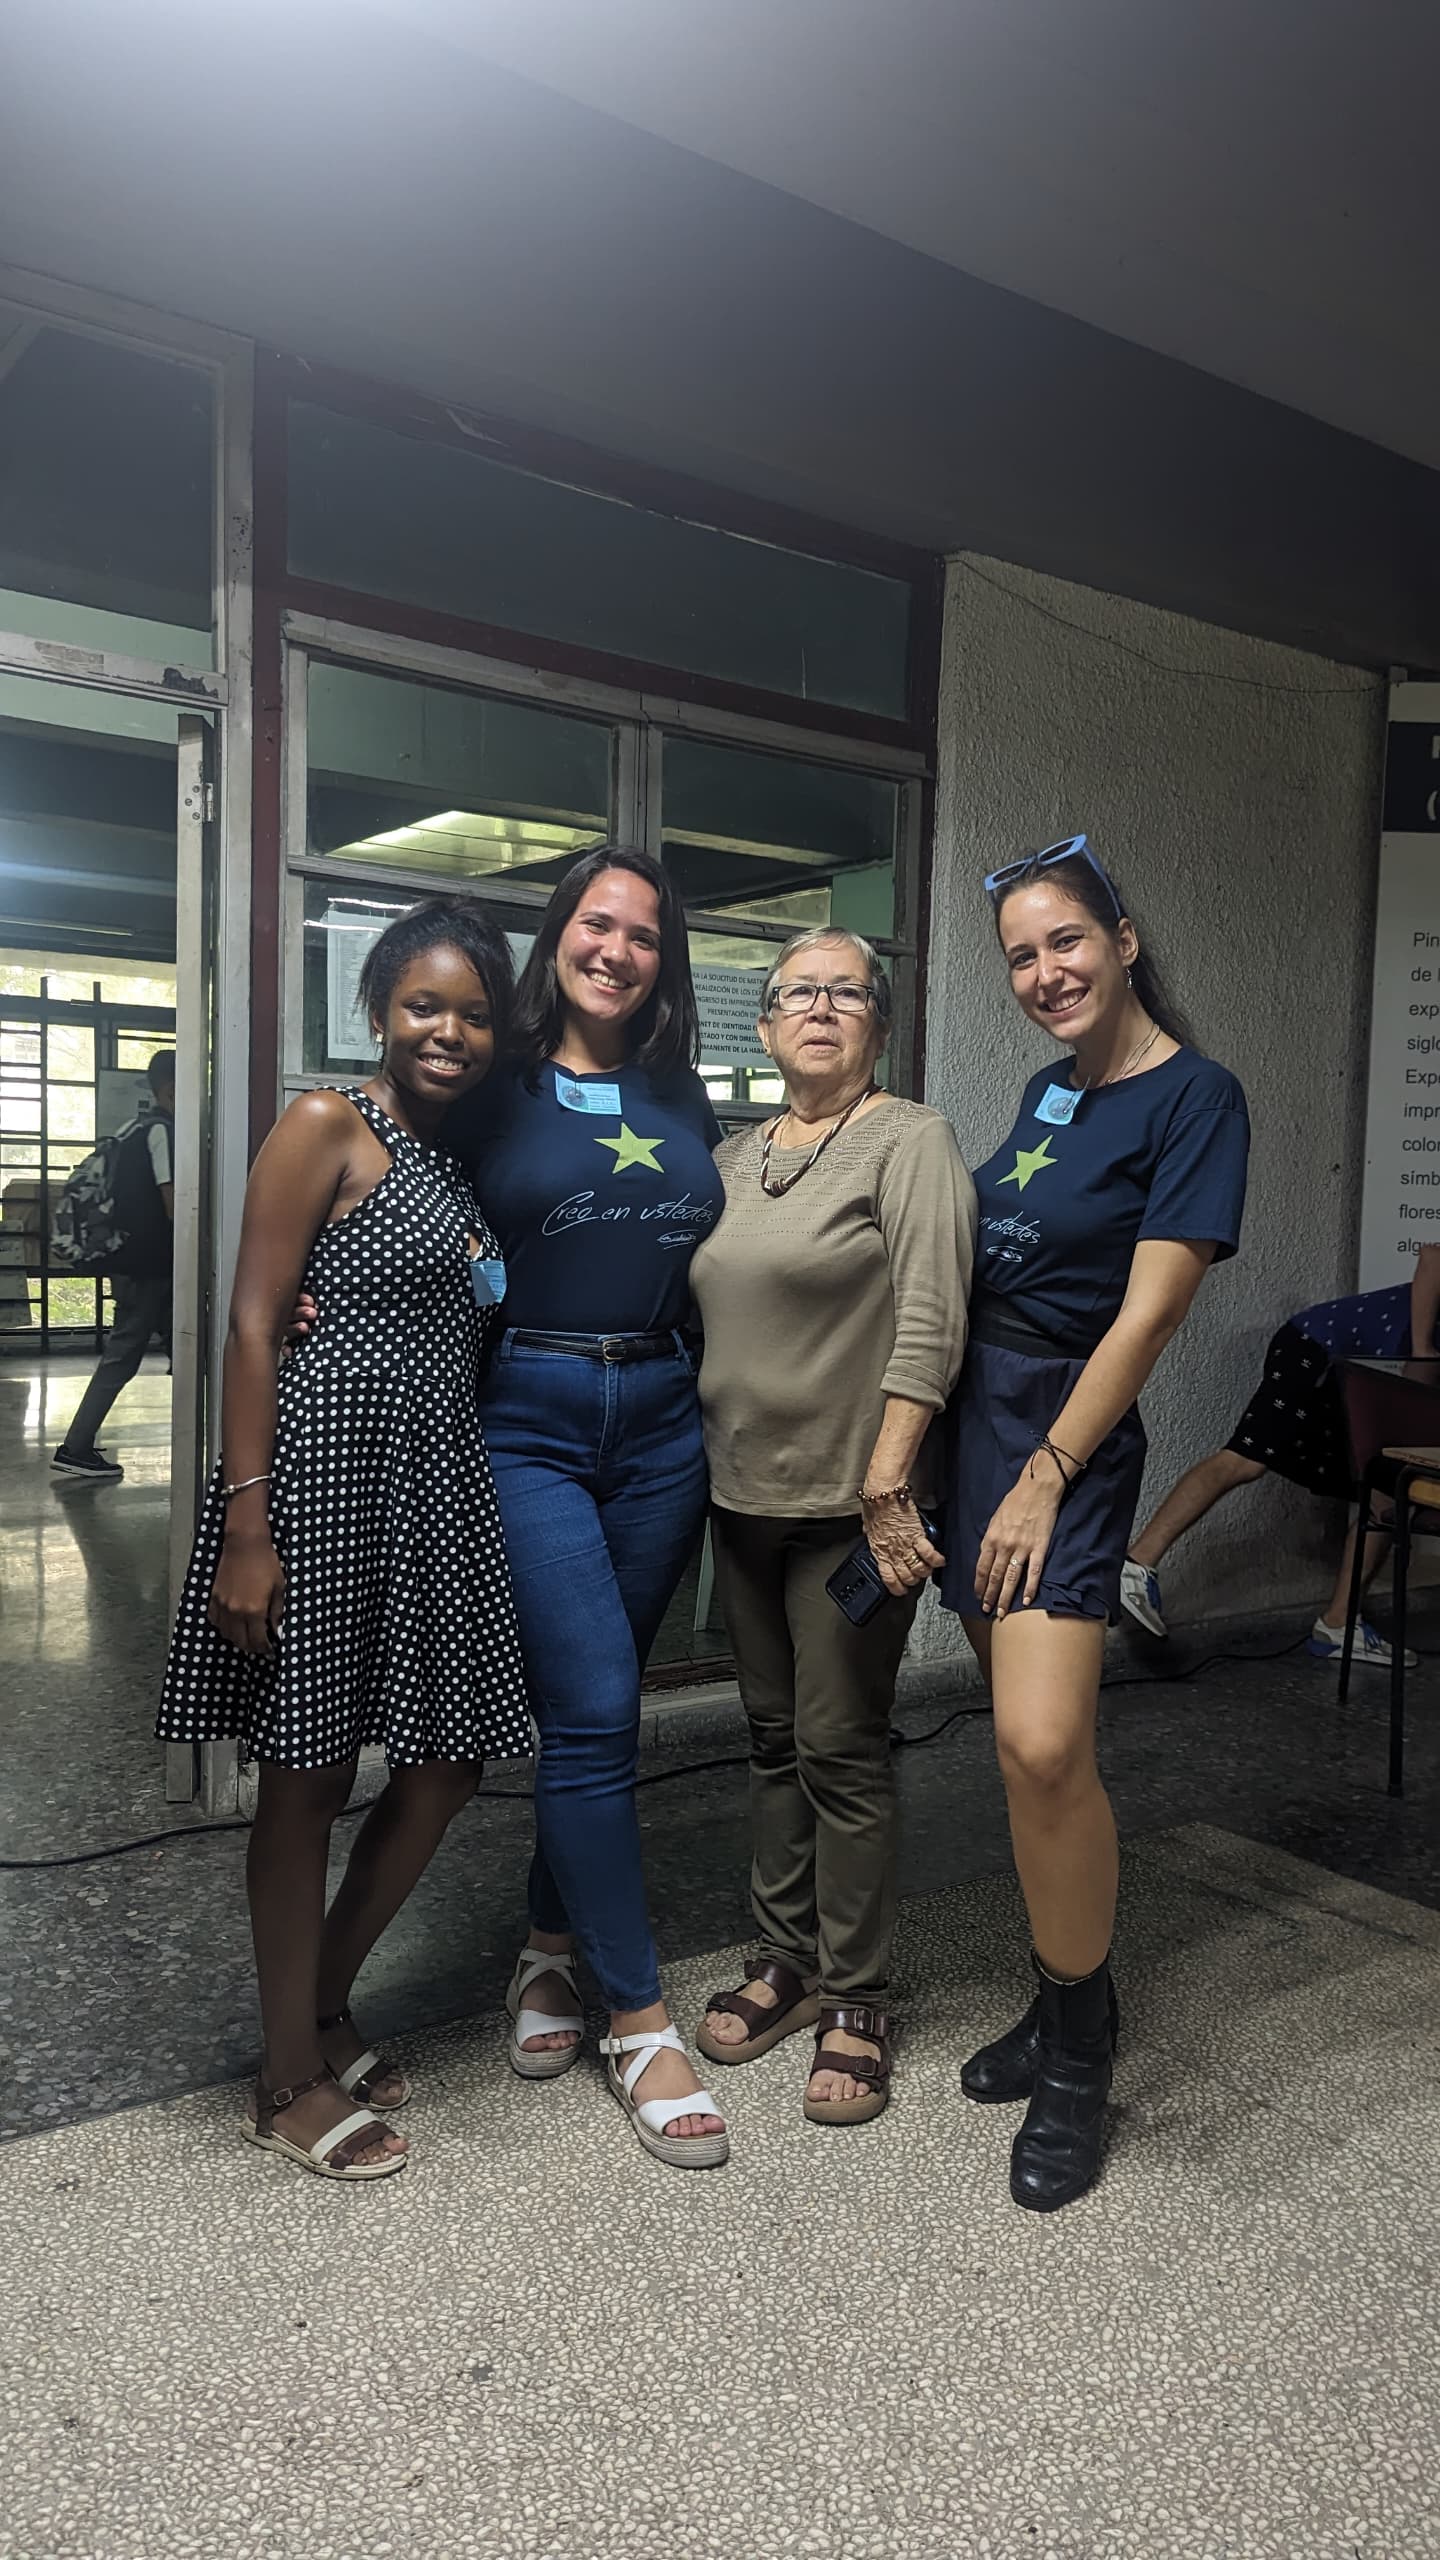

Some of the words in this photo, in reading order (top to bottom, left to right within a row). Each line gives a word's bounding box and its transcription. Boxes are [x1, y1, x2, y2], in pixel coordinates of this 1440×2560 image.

[1411, 967, 1432, 982] de
[1405, 1068, 1440, 1088] Exp
[542, 1190, 600, 1236] Creo
[601, 1206, 631, 1221] en
